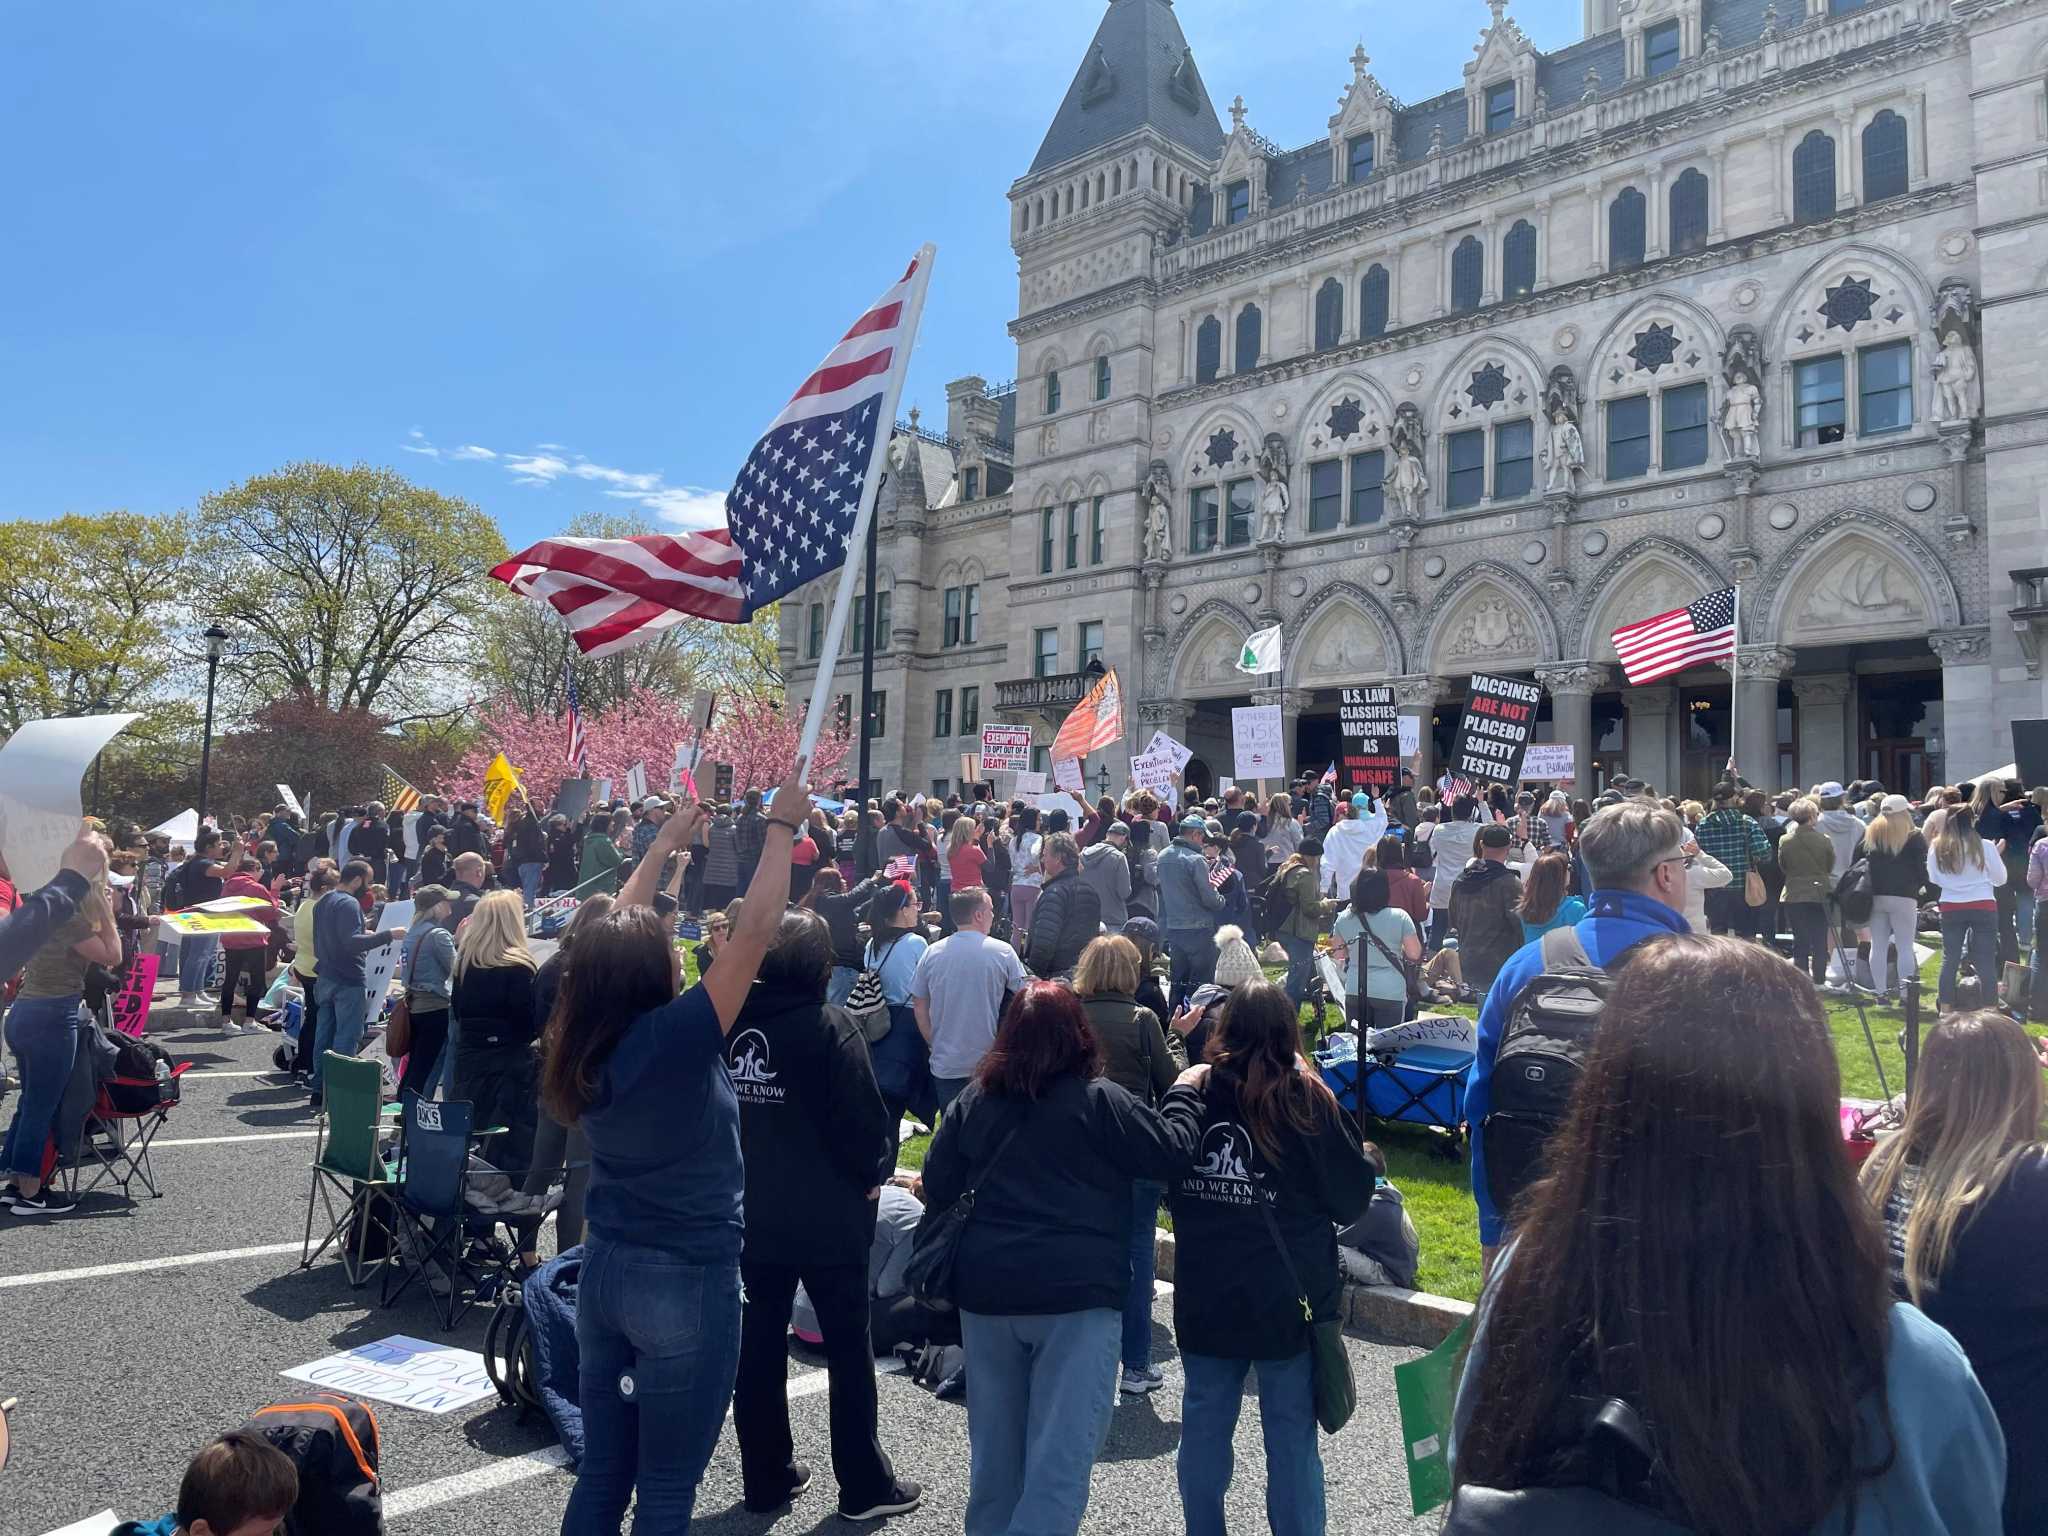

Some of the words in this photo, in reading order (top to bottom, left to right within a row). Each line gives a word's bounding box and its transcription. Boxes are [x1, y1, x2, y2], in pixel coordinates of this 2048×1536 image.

[1342, 689, 1364, 703] U.S.
[1365, 688, 1390, 703] LAW
[1471, 674, 1540, 703] VACCINES
[1340, 705, 1396, 719] CLASSIFIES
[1471, 695, 1499, 714] ARE
[1500, 701, 1530, 721] NOT
[1238, 723, 1280, 740] RISK
[1341, 721, 1398, 736] VACCINES
[1464, 714, 1526, 741] PLACEBO
[987, 732, 1027, 746] EXEMPTION
[1363, 739, 1379, 753] AS
[1004, 746, 1014, 754] OUT
[1465, 735, 1516, 760] SAFETY
[983, 758, 1007, 769] DEATH
[1462, 755, 1511, 780] TESTED
[1352, 770, 1393, 784] UNSAFE
[1418, 1017, 1460, 1030] NOT
[1398, 1030, 1470, 1042] ANTI-VAX
[735, 1082, 751, 1095] WE
[753, 1085, 786, 1097] KNOW
[1200, 1193, 1233, 1203] ROMANS
[1209, 1181, 1229, 1194] WE
[1233, 1183, 1277, 1201] KNW
[309, 1364, 410, 1394] CHILD
[391, 1386, 468, 1409] MY
